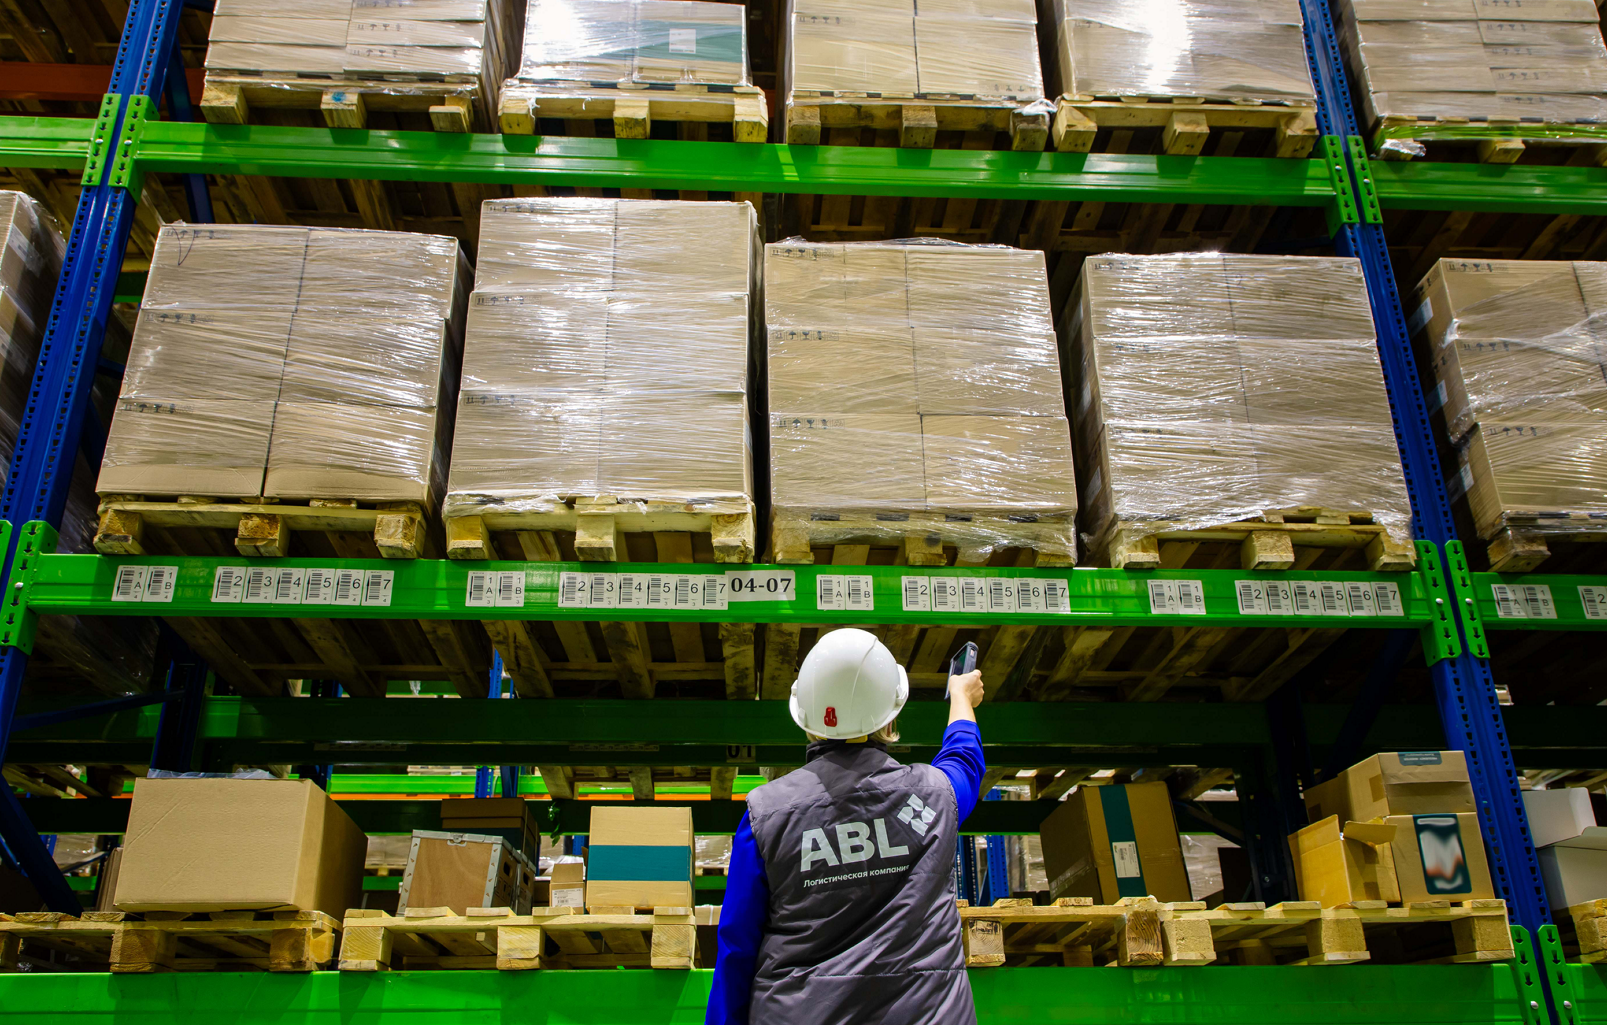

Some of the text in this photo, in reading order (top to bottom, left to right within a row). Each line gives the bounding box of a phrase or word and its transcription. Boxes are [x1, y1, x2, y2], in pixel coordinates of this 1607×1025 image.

[234, 576, 242, 586] 2
[264, 577, 272, 586] 3
[293, 578, 301, 587] 4
[323, 578, 331, 588] 5
[352, 579, 361, 589] 6
[383, 579, 391, 589] 7
[578, 581, 586, 591] 2
[731, 578, 791, 592] 04-07
[606, 582, 614, 592] 3
[635, 582, 642, 592] 4
[663, 583, 670, 593] 5
[691, 583, 698, 593] 6
[719, 584, 726, 593] 7
[920, 585, 928, 595] 2
[949, 586, 957, 595] 3
[977, 587, 984, 596] 4
[1005, 587, 1012, 597] 5
[1032, 587, 1040, 597] 6
[1059, 588, 1066, 597] 7
[1254, 590, 1262, 599] 2
[1282, 590, 1289, 599] 3
[1309, 590, 1317, 599] 4
[1336, 591, 1344, 600] 5
[1363, 591, 1371, 600] 6
[1390, 591, 1397, 600] 7
[800, 818, 909, 872] ABL
[803, 871, 868, 888] Логистическая
